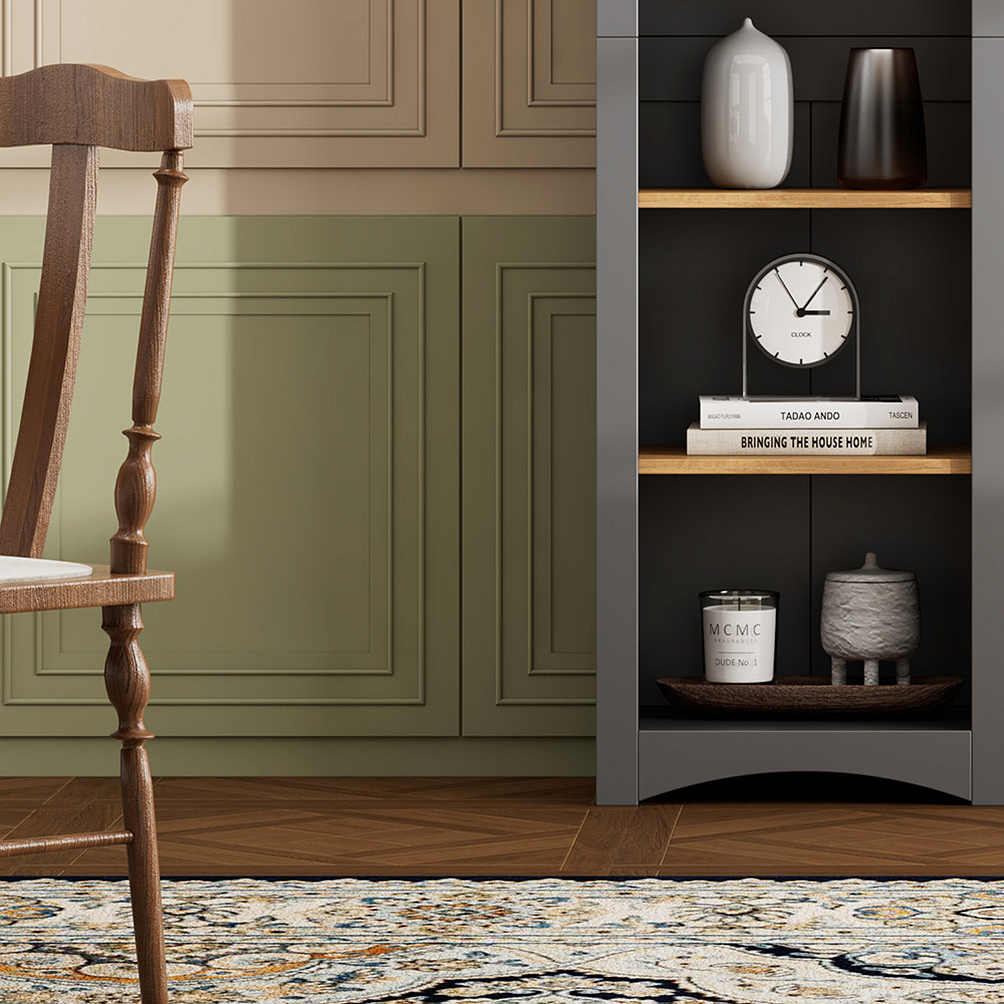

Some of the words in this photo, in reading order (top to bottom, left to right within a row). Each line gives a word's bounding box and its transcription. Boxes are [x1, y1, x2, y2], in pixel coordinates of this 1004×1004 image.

[780, 411, 812, 421] TADAO
[813, 411, 841, 421] ANDO
[888, 411, 913, 420] TASCEN
[741, 436, 788, 449] BRINGING
[790, 436, 809, 449] THE
[811, 436, 844, 449] HOUSE
[845, 436, 874, 449] HOME
[715, 658, 736, 667] DUDE
